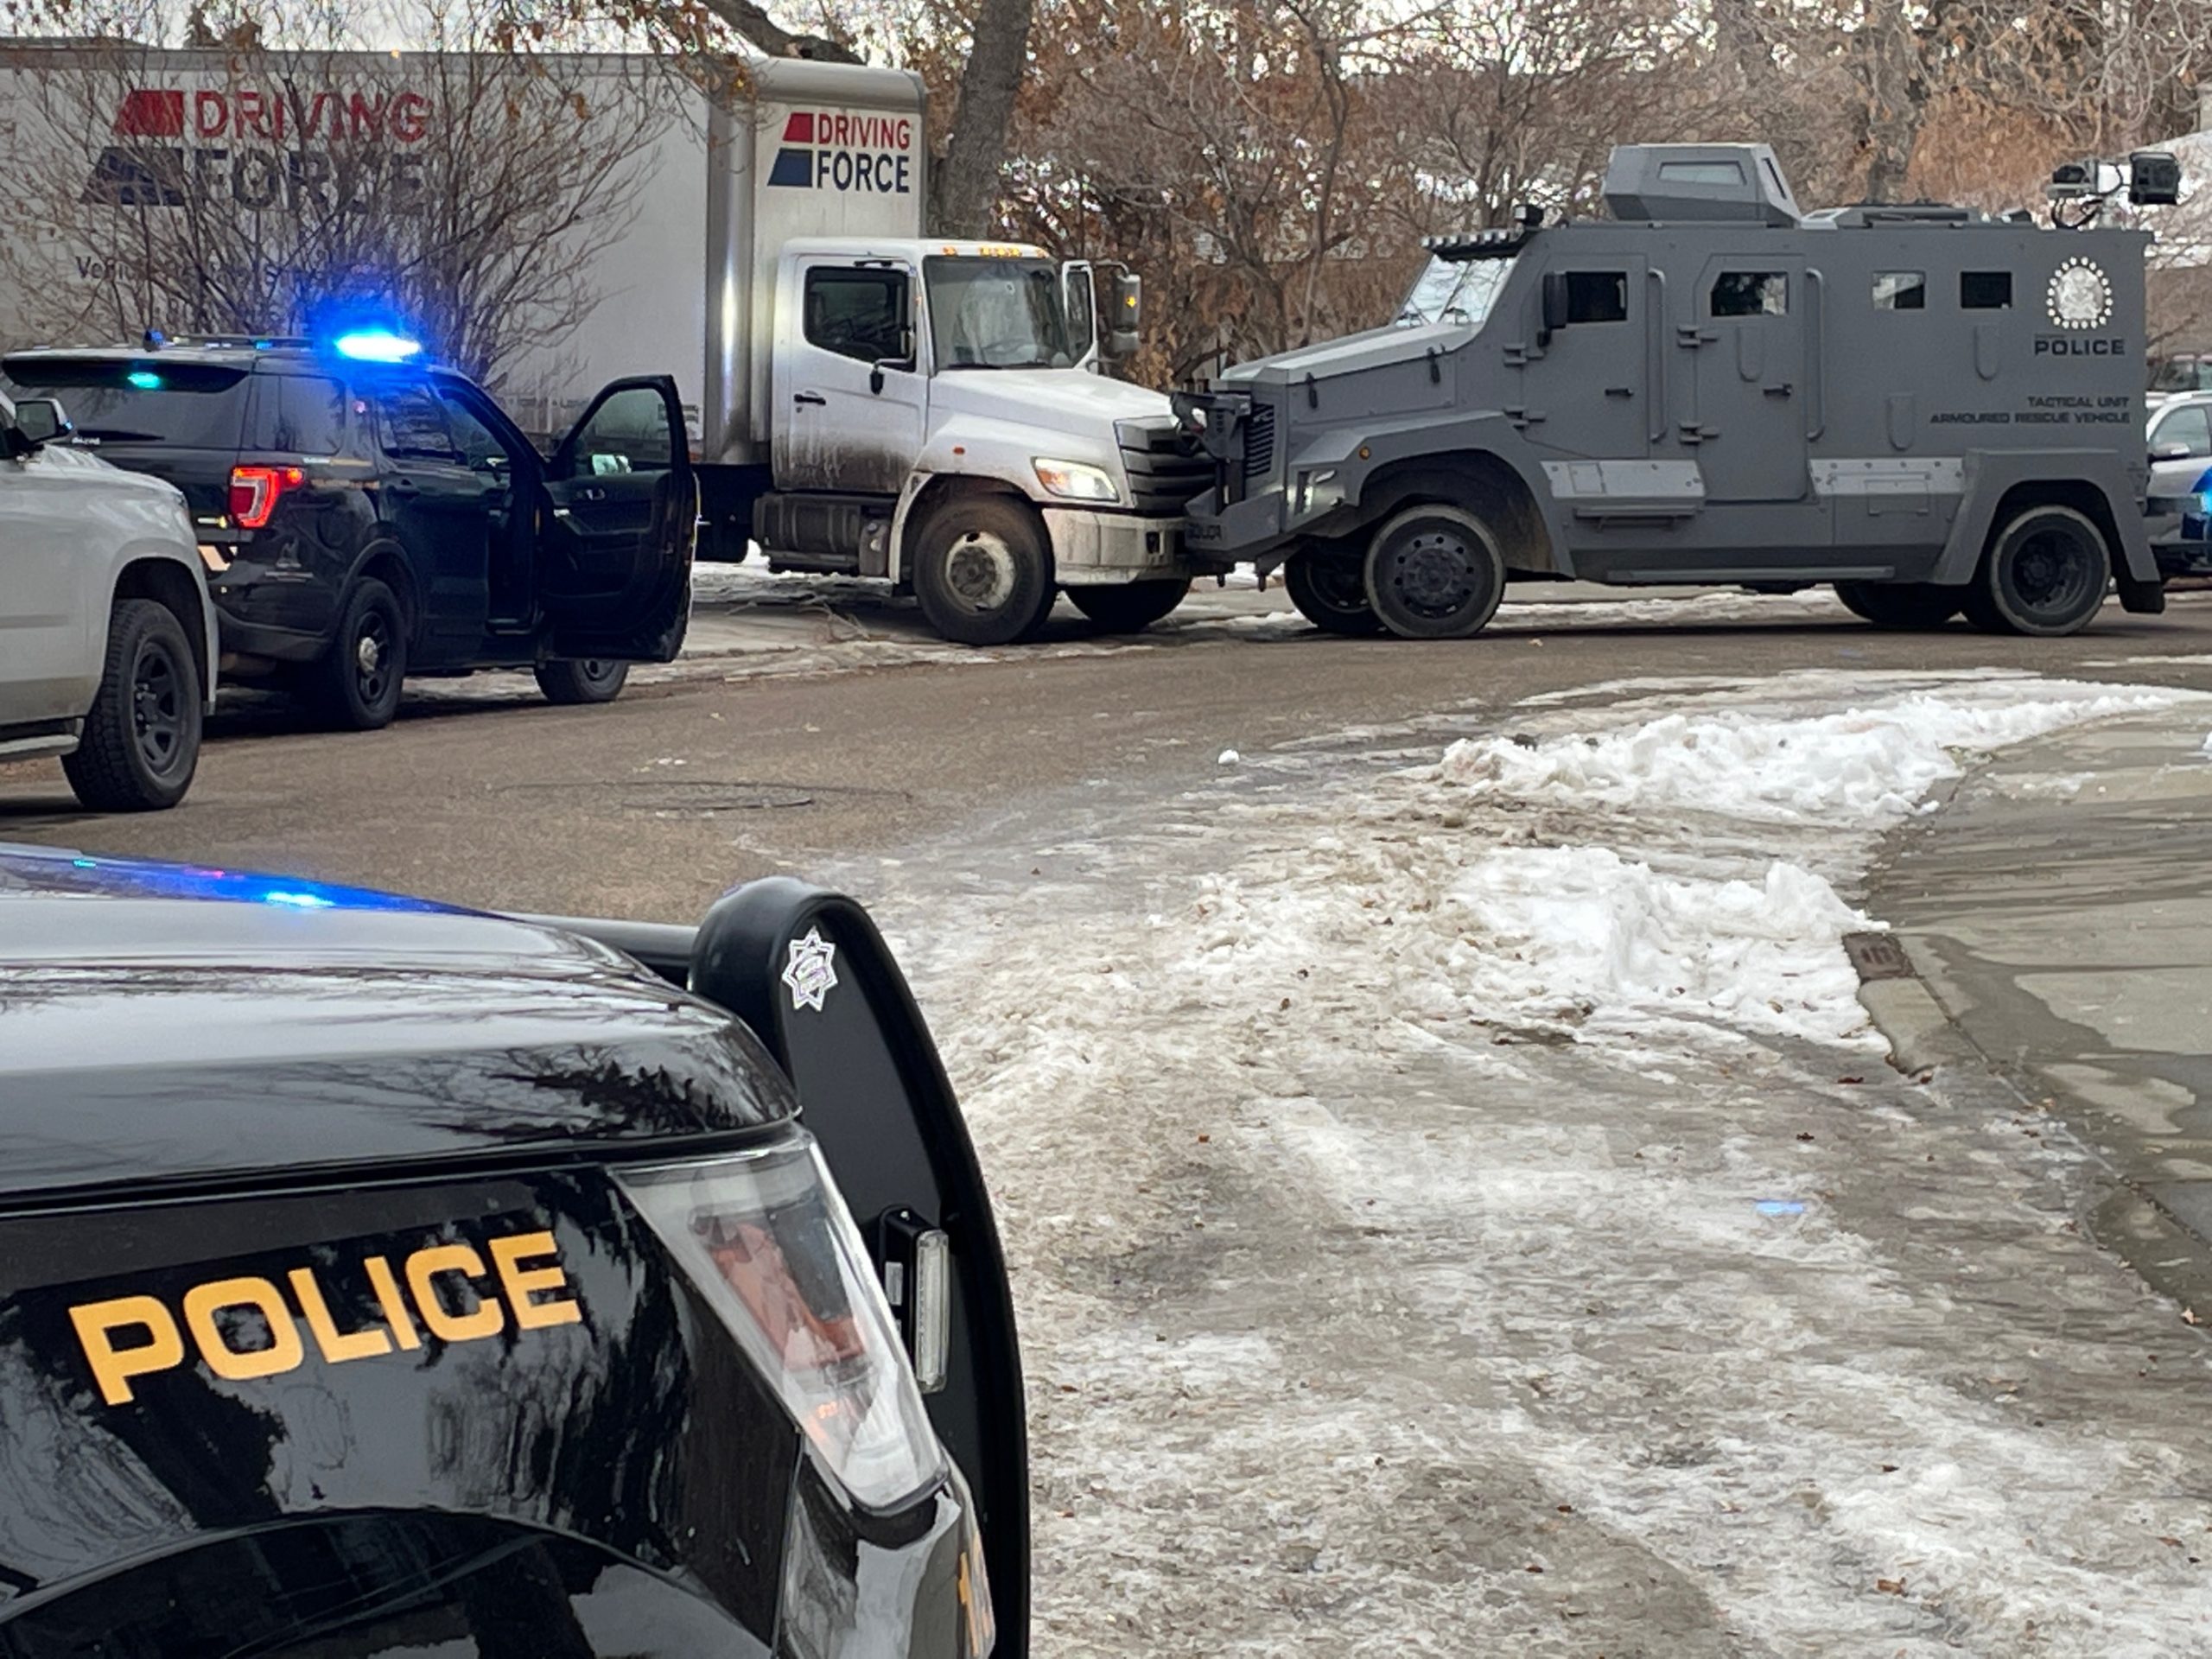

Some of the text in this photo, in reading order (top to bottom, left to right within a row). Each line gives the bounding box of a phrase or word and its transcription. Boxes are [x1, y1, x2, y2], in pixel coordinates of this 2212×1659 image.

[195, 90, 432, 143] DRIVING
[818, 112, 911, 150] DRIVING
[817, 150, 910, 193] FORCE
[2034, 339, 2126, 356] POLICE
[1930, 412, 2131, 424] ARMOURED RESCUE VEHICLE
[2028, 397, 2130, 408] TACTICAL UNIT
[68, 1230, 582, 1406] POLICE
